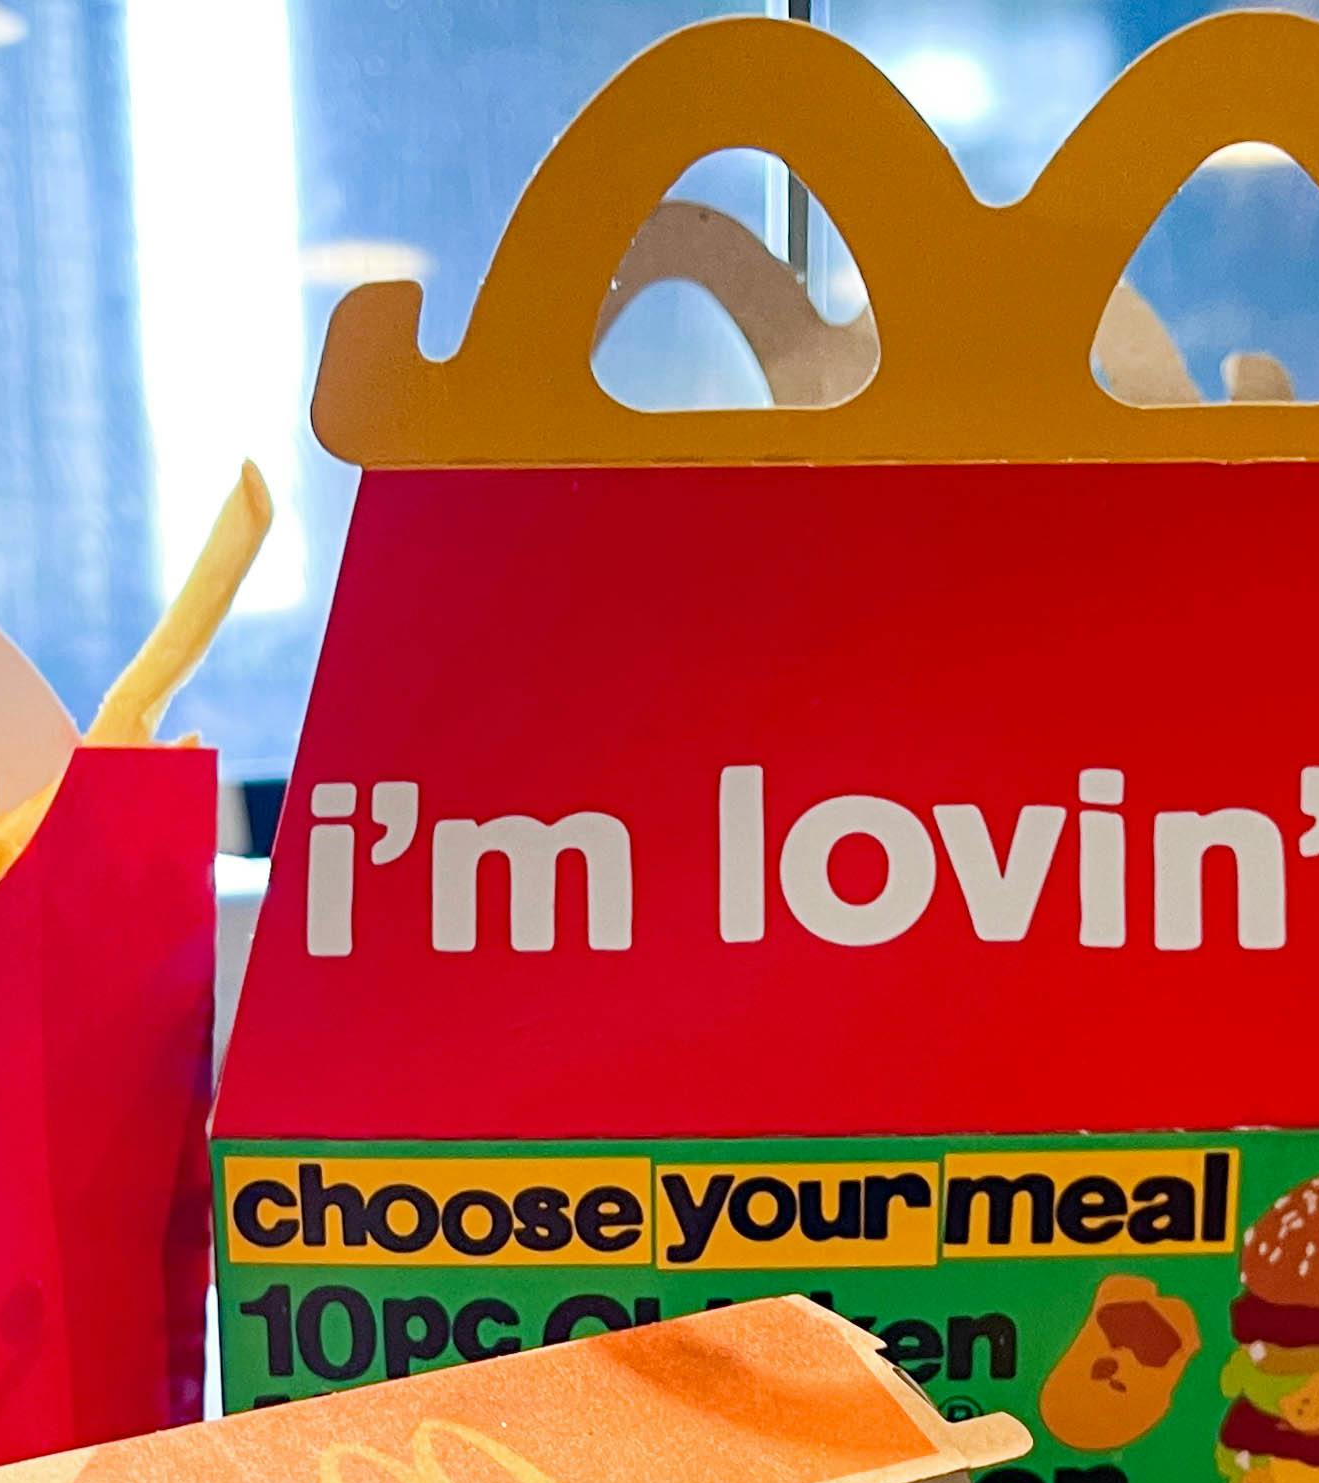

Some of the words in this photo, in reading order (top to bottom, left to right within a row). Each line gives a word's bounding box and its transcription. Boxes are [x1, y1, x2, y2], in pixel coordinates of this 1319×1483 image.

[306, 780, 633, 957] i'm
[233, 1163, 643, 1257] choose
[661, 1172, 931, 1263] your
[944, 1152, 1229, 1245] meal
